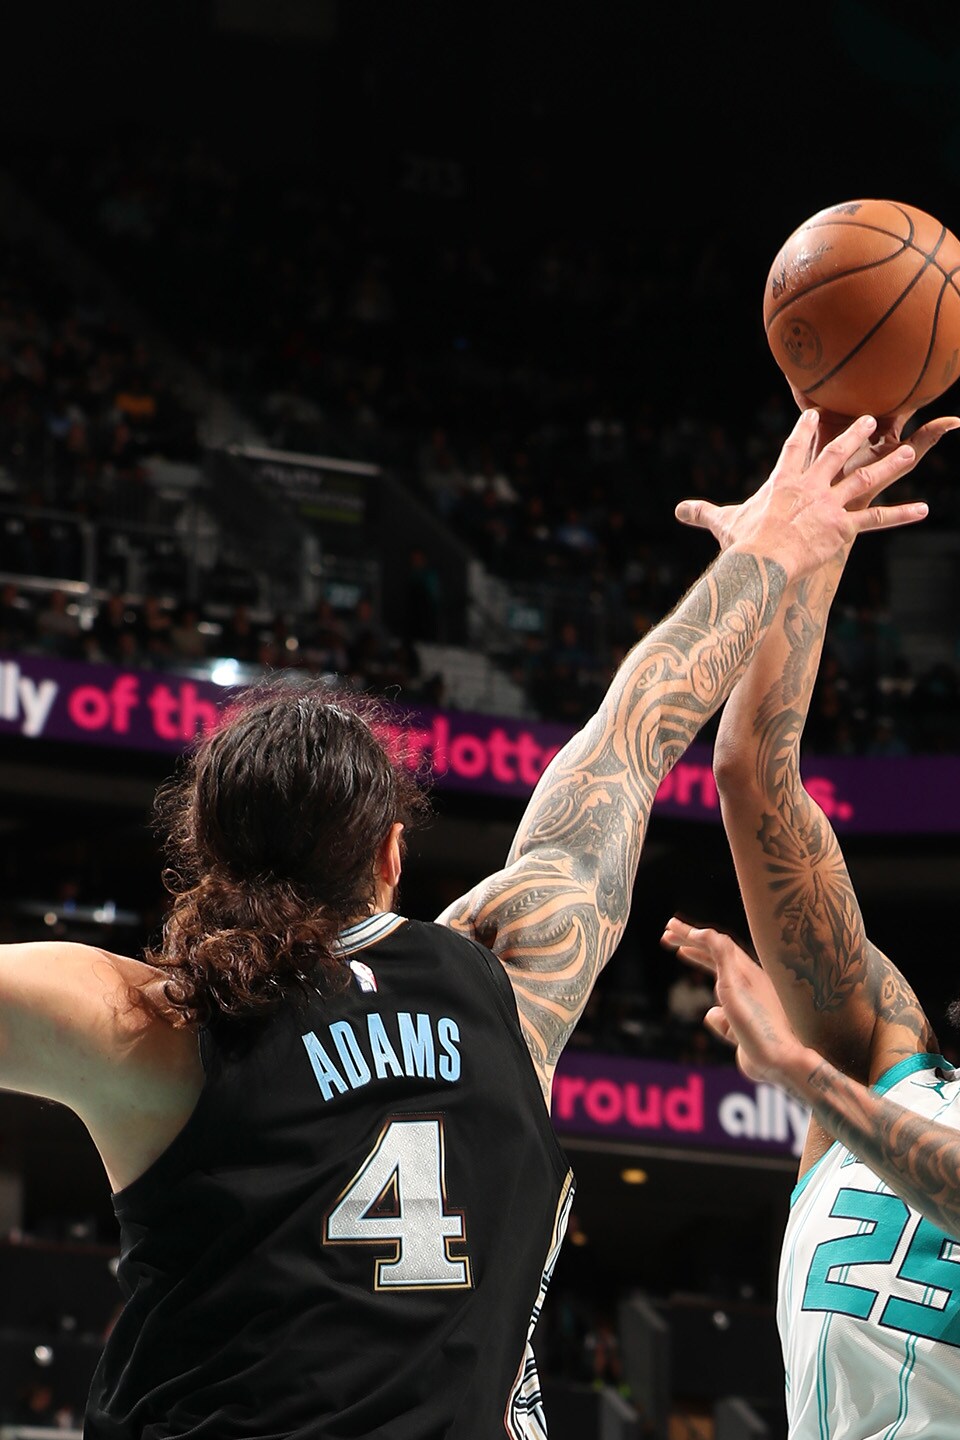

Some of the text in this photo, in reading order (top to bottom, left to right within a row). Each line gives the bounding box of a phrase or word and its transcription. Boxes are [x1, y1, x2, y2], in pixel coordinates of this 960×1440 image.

[68, 673, 140, 734] of
[147, 682, 228, 740] th
[301, 1012, 462, 1101] ADAMS
[556, 1074, 705, 1131] roud
[322, 1113, 472, 1291] 4
